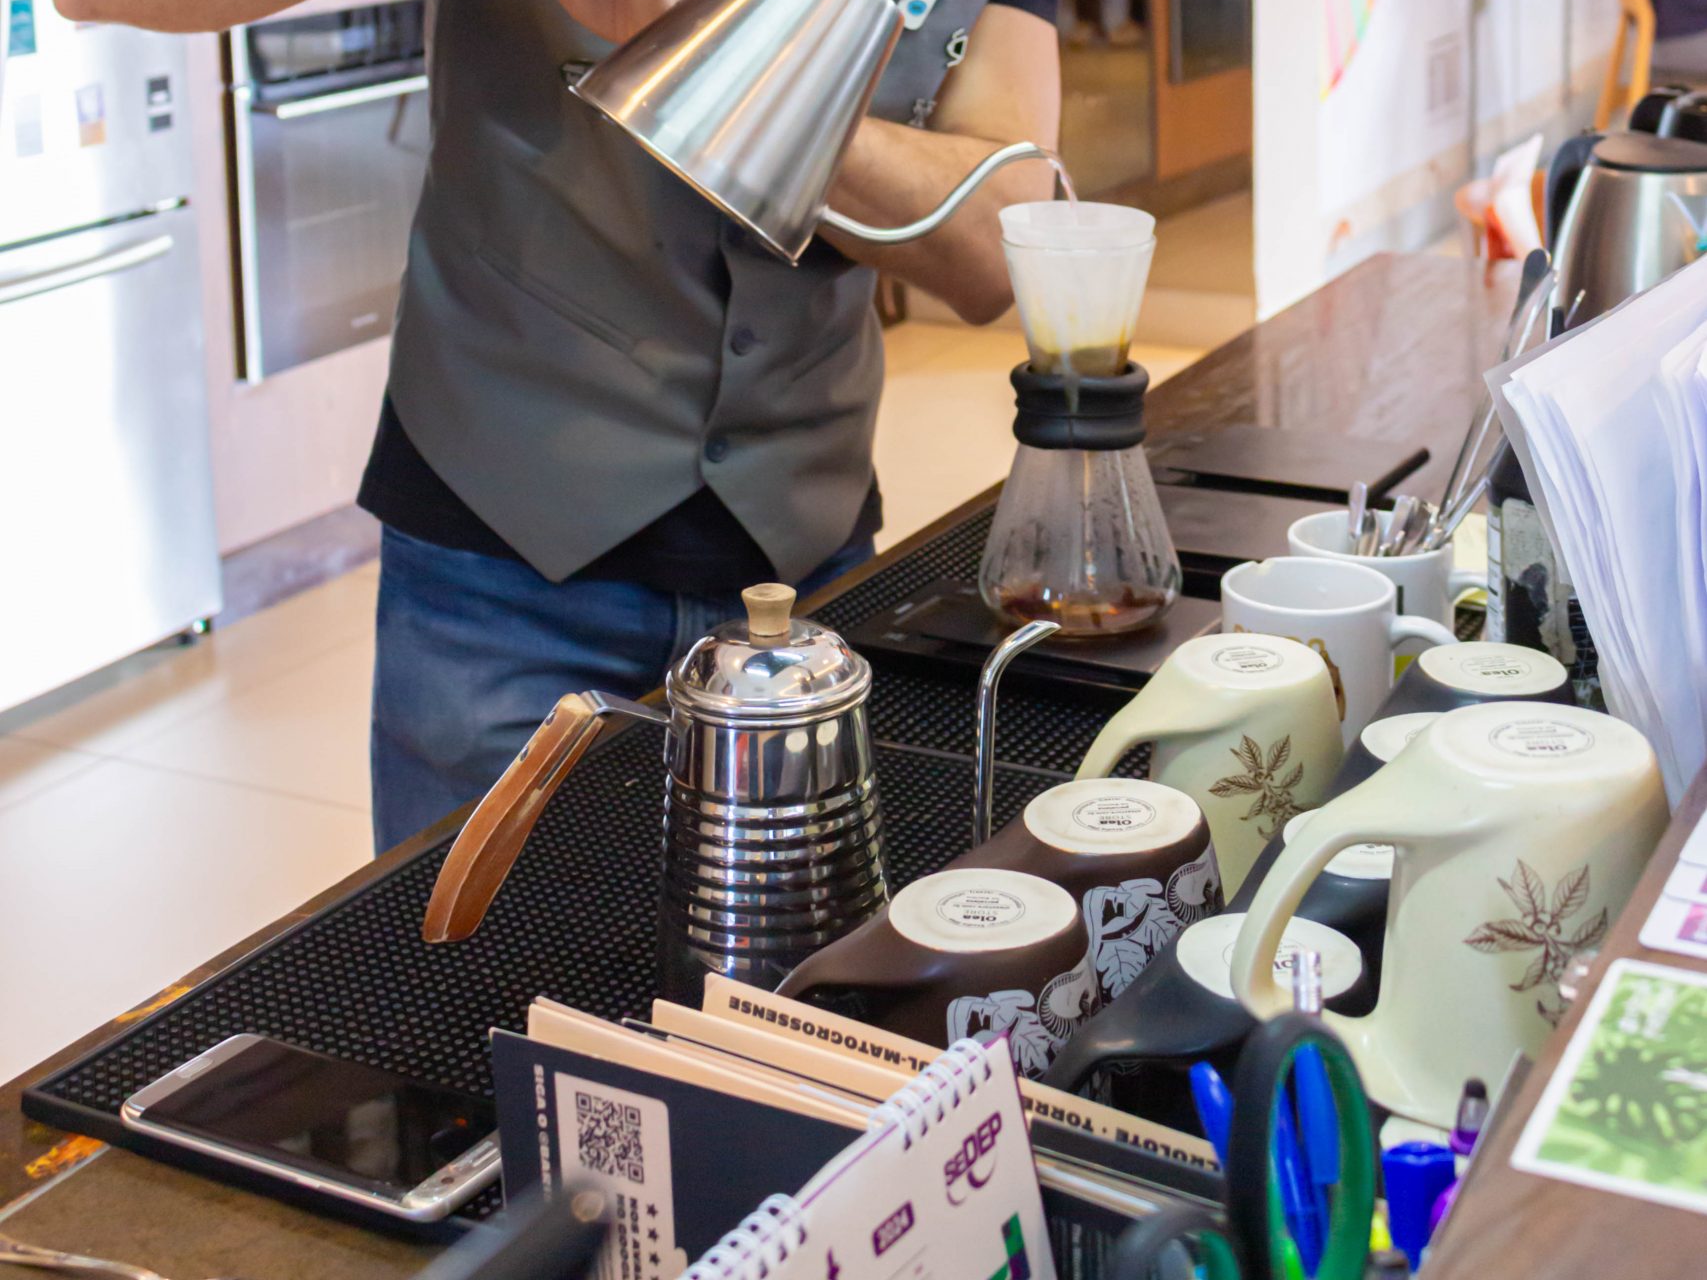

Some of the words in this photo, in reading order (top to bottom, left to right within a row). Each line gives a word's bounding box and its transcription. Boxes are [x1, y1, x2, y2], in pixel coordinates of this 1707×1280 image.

[729, 996, 931, 1071] UL-MATOGROSSENSE
[533, 1064, 547, 1109] SIGA
[537, 1113, 548, 1128] O
[1022, 1096, 1094, 1133] TORRE
[630, 1197, 640, 1234] NOS
[618, 1223, 630, 1280] GOOGL
